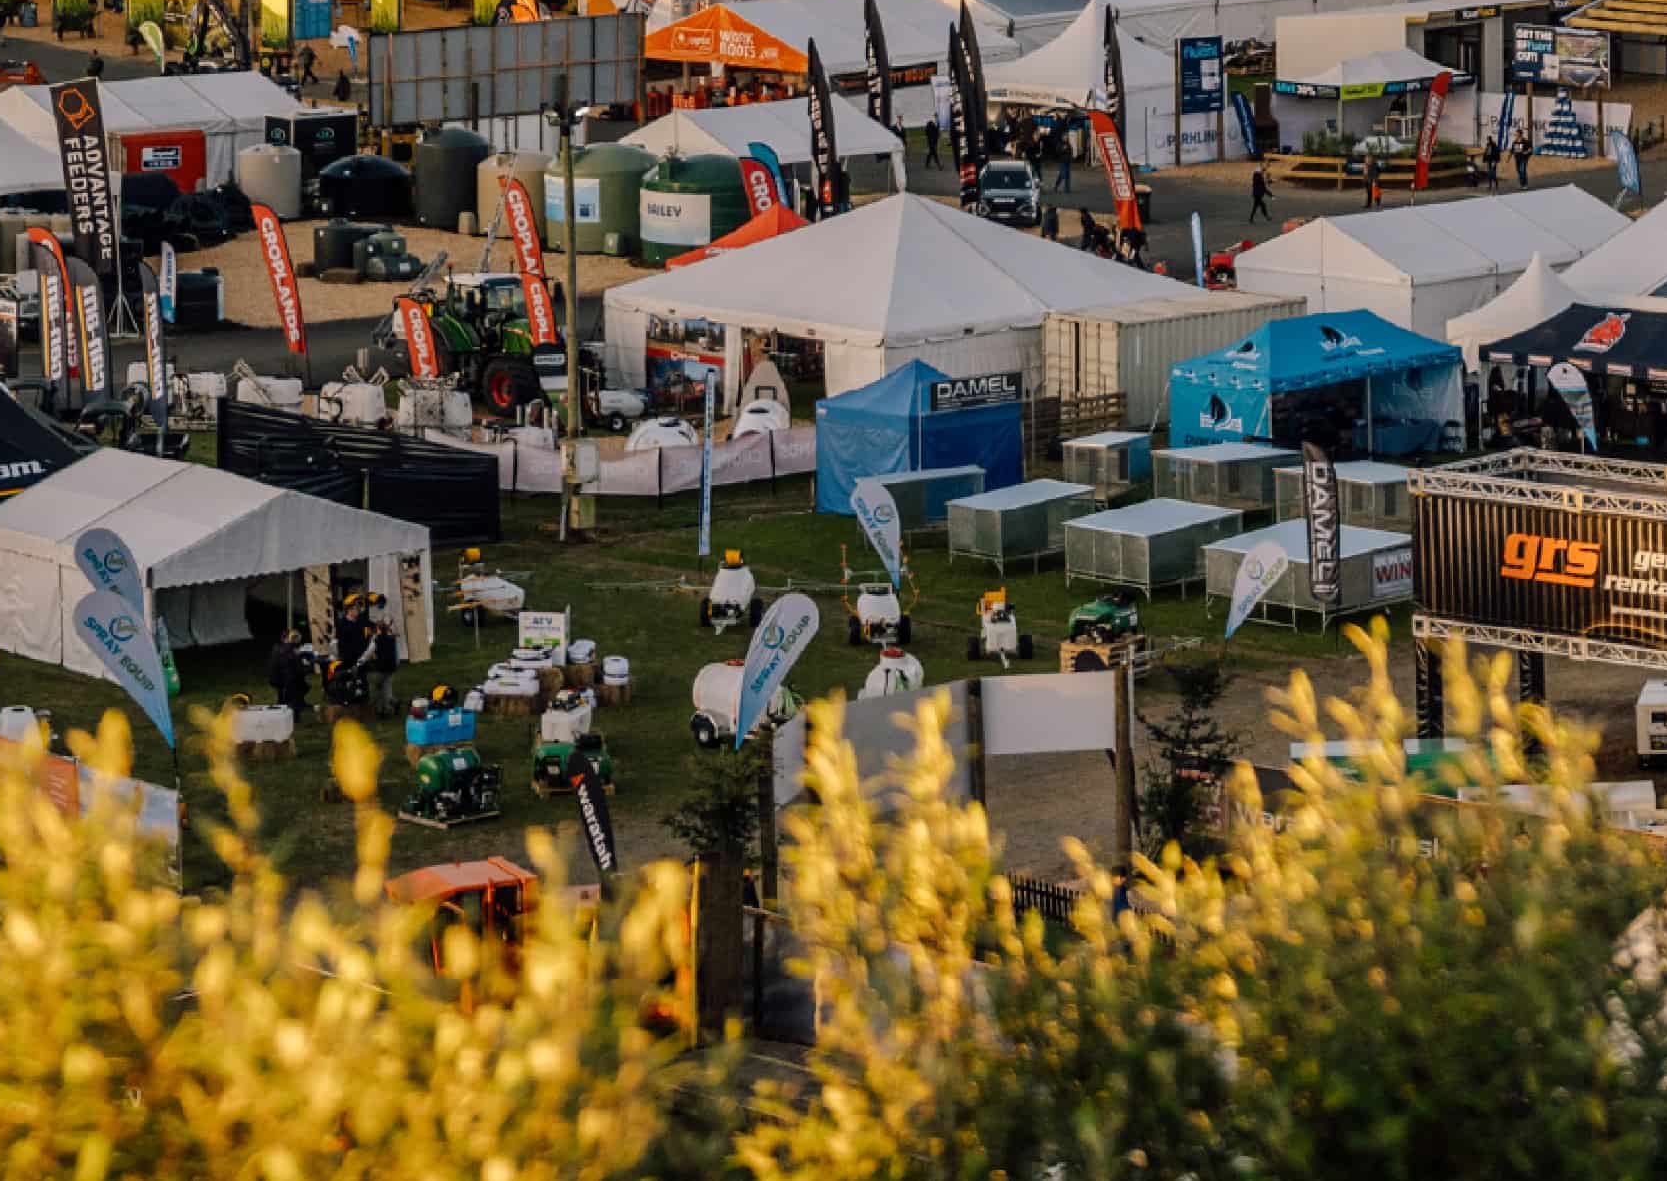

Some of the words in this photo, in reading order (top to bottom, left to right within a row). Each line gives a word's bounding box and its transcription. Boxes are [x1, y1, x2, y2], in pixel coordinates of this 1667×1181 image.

[63, 136, 95, 235] FEEDERS
[82, 134, 113, 260] ADVANTAGE
[261, 216, 300, 343] CROPLANDS
[408, 307, 433, 378] CROPLA
[936, 373, 1017, 400] DAMEL
[1310, 461, 1339, 583] DAMEL
[1501, 533, 1601, 588] grs
[1375, 562, 1412, 583] WIN
[83, 616, 122, 656] SPRAY
[576, 783, 611, 870] waratah
